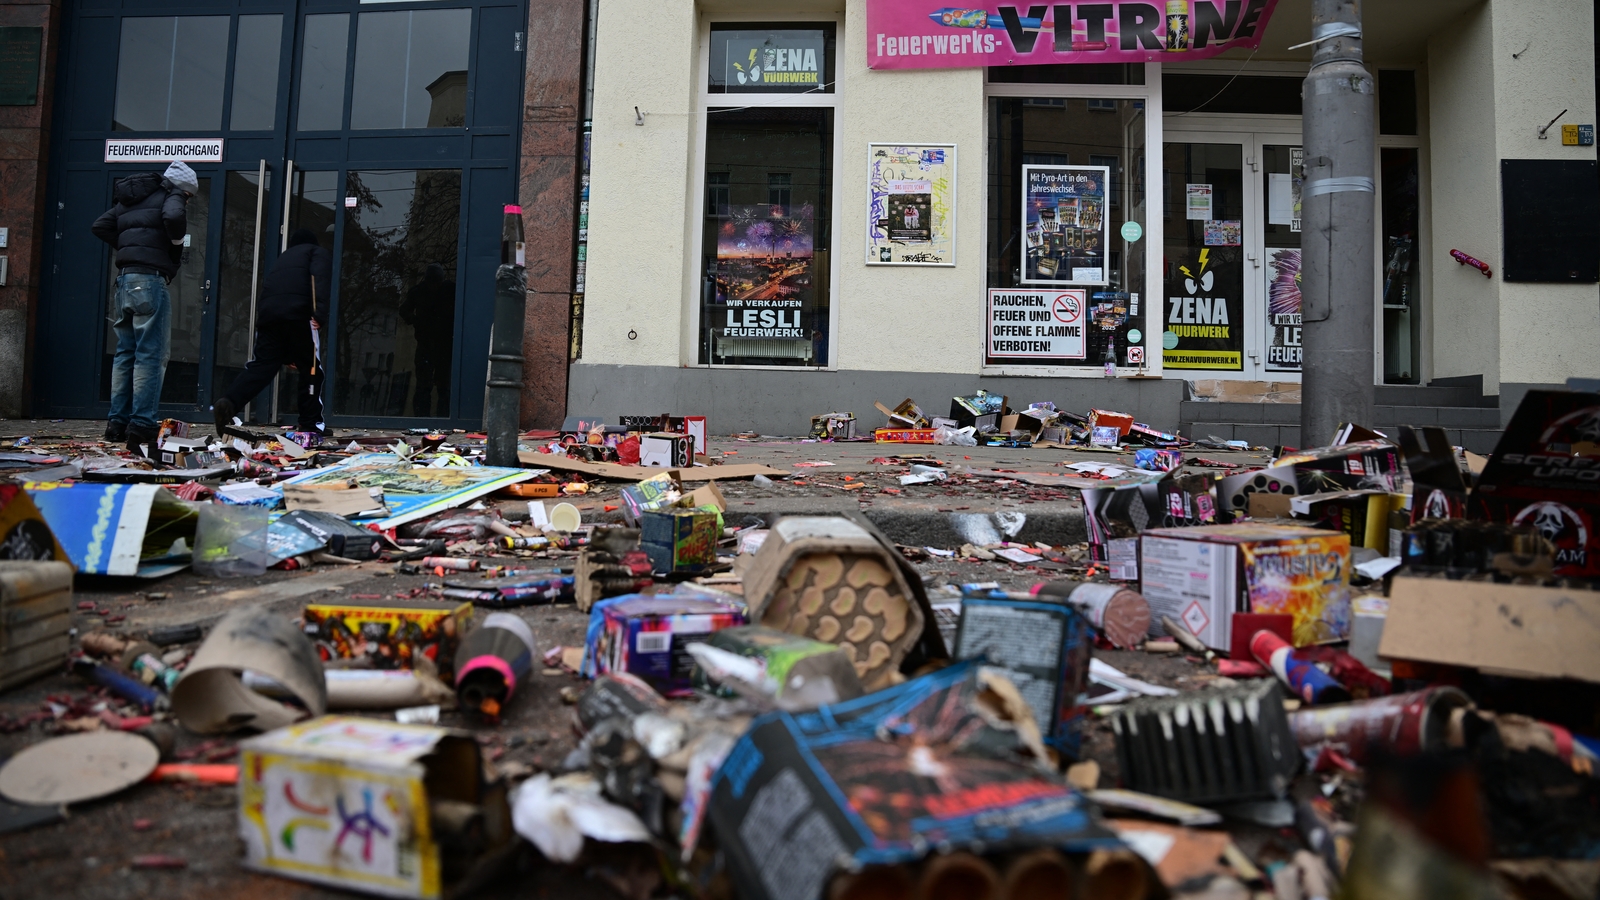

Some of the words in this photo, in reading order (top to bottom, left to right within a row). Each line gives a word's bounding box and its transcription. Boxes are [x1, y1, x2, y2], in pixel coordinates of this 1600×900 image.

[876, 30, 1003, 57] Feuerwerks-
[763, 48, 818, 71] ZENA
[763, 72, 818, 83] VUURWERK
[108, 144, 220, 156] FEUERWEHR-DURCHGANG
[1030, 173, 1041, 182] Mit
[1041, 173, 1067, 184] Pyro-Art
[1069, 173, 1075, 182] in
[1076, 174, 1088, 183] den
[1030, 184, 1076, 193] Jahreswechsel.
[993, 295, 1046, 308] RAUCHEN,
[993, 310, 1026, 321] FEUER
[1029, 310, 1051, 322] UND
[1168, 297, 1229, 325] ZENA
[726, 309, 801, 328] LESLI
[1277, 314, 1290, 324] WIR
[723, 327, 804, 338] FEUERWERK!
[993, 325, 1032, 337] OFFENE
[1035, 326, 1081, 337] FLAMME
[1168, 325, 1230, 338] VUURWERK
[993, 340, 1051, 352] VERBOTEN!
[1270, 346, 1302, 363] FEUER
